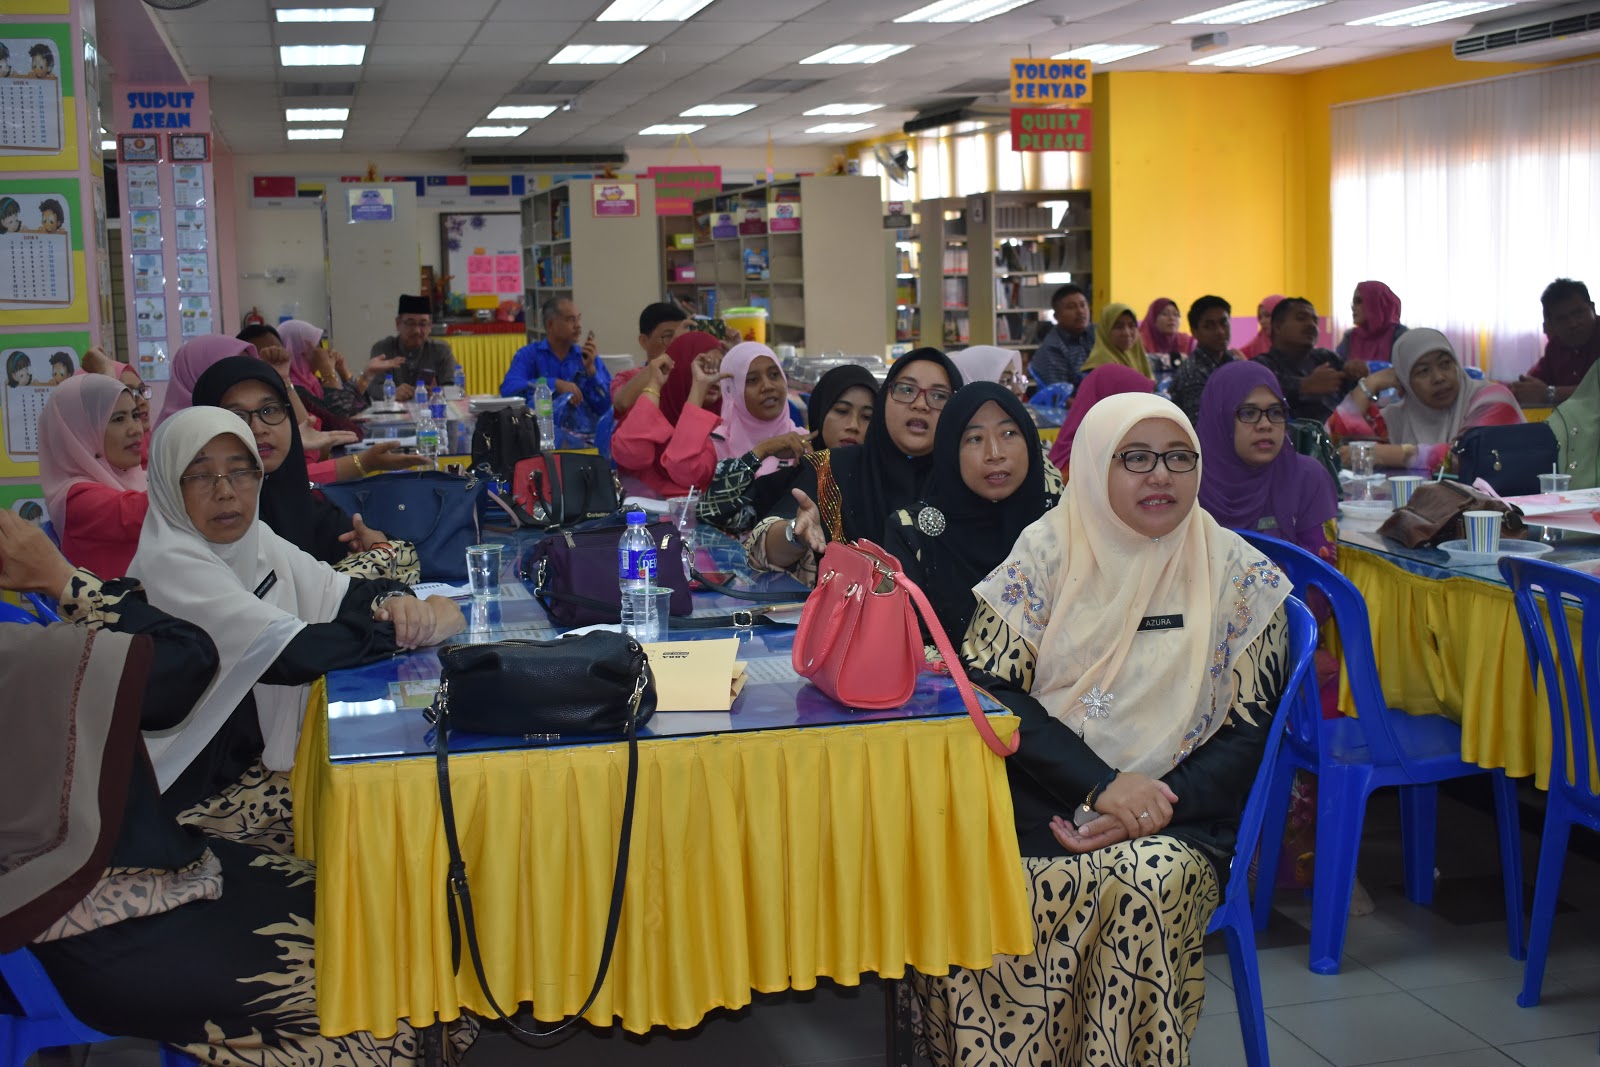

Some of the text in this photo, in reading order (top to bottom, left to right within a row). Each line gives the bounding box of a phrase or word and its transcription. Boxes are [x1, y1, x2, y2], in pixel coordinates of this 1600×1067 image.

[1015, 63, 1087, 79] TOLONG
[1015, 83, 1087, 98] SENYAP
[127, 92, 195, 109] SUDUT
[132, 112, 191, 129] ASEAN
[1021, 114, 1080, 132] QUIET
[1019, 134, 1085, 148] PLEASE
[1145, 618, 1172, 627] AZURA
